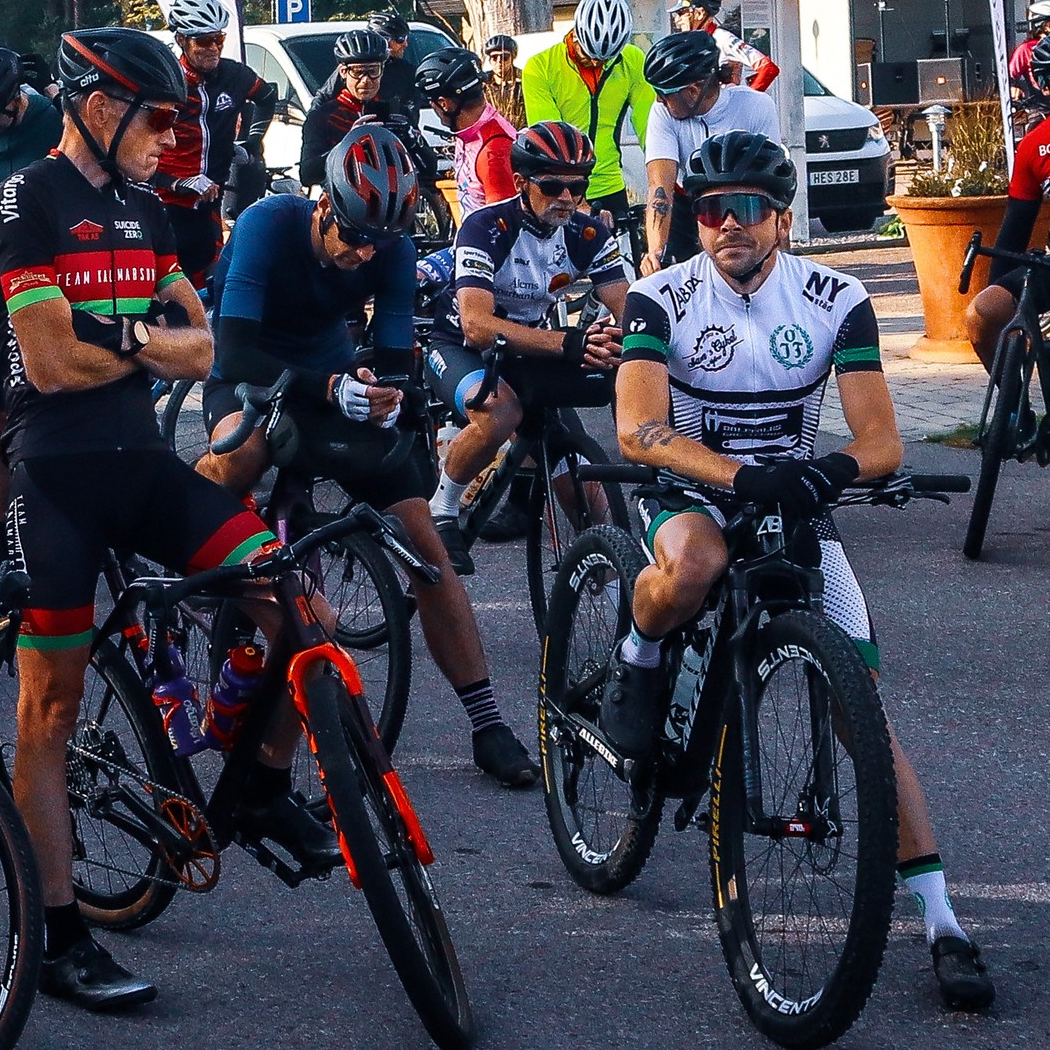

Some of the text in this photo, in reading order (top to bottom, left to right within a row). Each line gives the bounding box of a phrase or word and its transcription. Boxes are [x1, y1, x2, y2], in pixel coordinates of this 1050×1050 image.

[813, 170, 855, 184] HES 28E
[113, 220, 142, 230] SUICIDE
[55, 271, 91, 287] TEAM
[805, 270, 850, 304] NY
[578, 727, 619, 769] ALLEBIKE
[710, 764, 723, 863] PIRELLI
